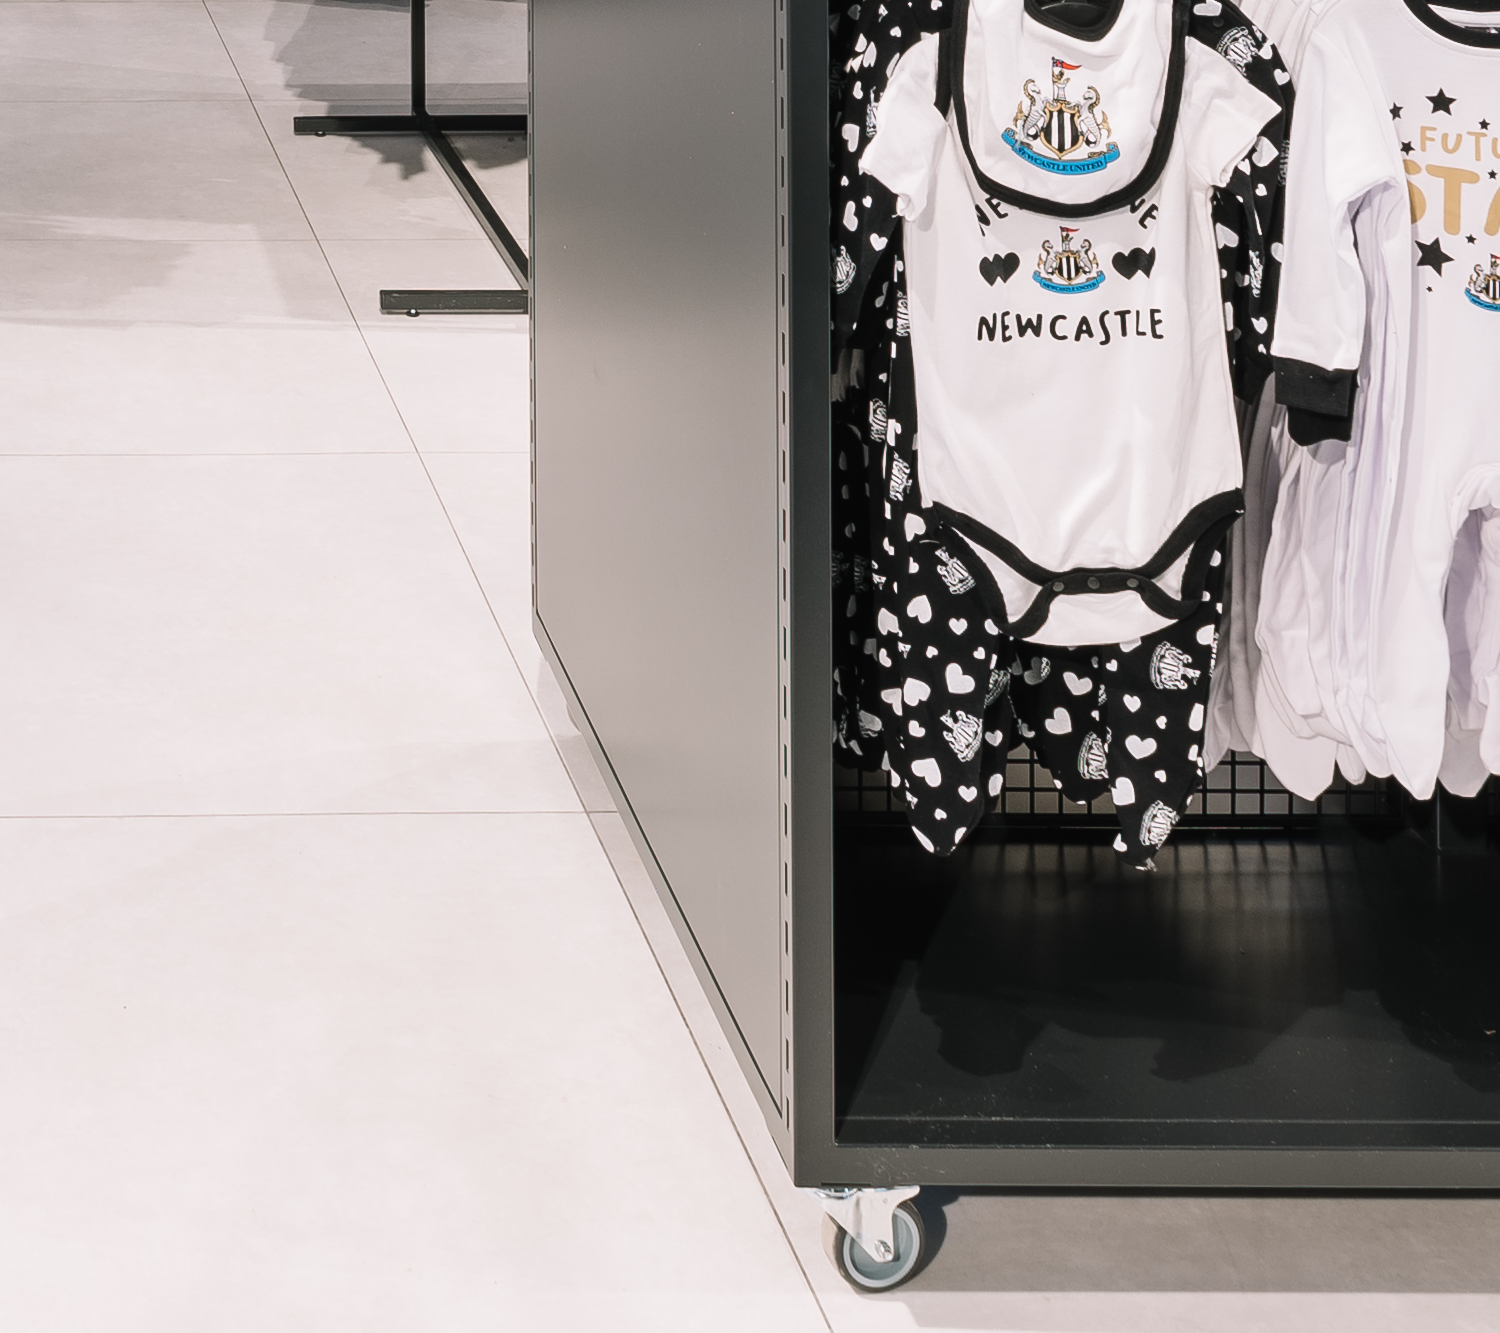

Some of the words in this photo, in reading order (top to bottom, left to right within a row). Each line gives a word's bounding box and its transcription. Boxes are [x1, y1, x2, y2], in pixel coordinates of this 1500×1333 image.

[1017, 147, 1068, 172] NEWCASTLE
[1069, 160, 1104, 172] UNITED
[977, 309, 1164, 346] NEWCASTLE
